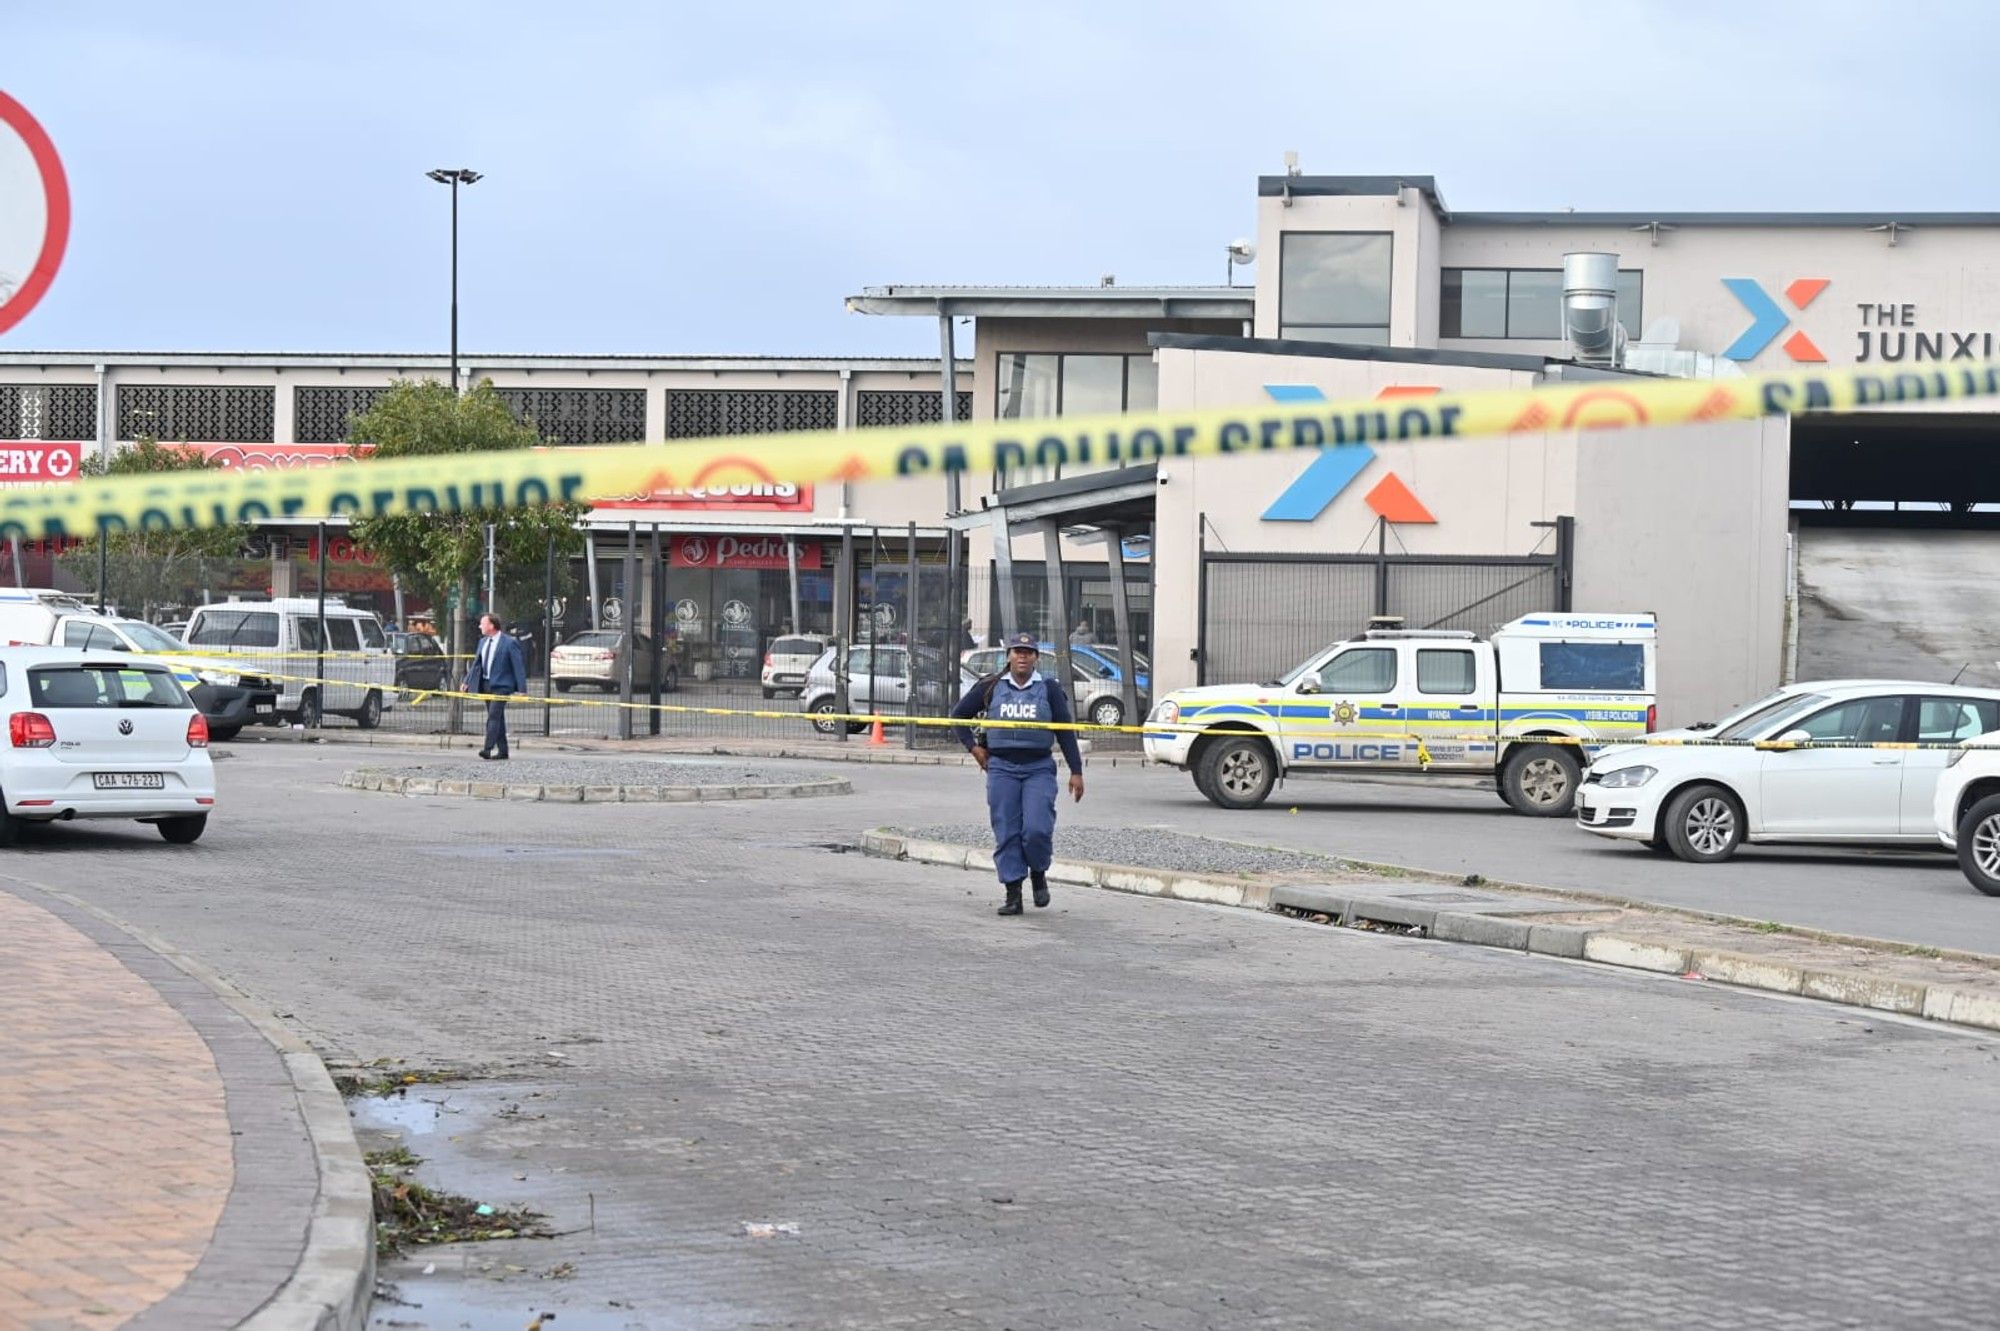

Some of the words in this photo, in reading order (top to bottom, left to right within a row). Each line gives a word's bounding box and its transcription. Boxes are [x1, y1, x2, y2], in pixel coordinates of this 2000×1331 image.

[1857, 303, 1915, 327] THE
[1855, 331, 2000, 363] JUNXI
[1572, 620, 1615, 630] POLICE
[1000, 703, 1036, 718] POLICE
[1294, 743, 1400, 760] POLICE
[98, 775, 117, 786] CAA
